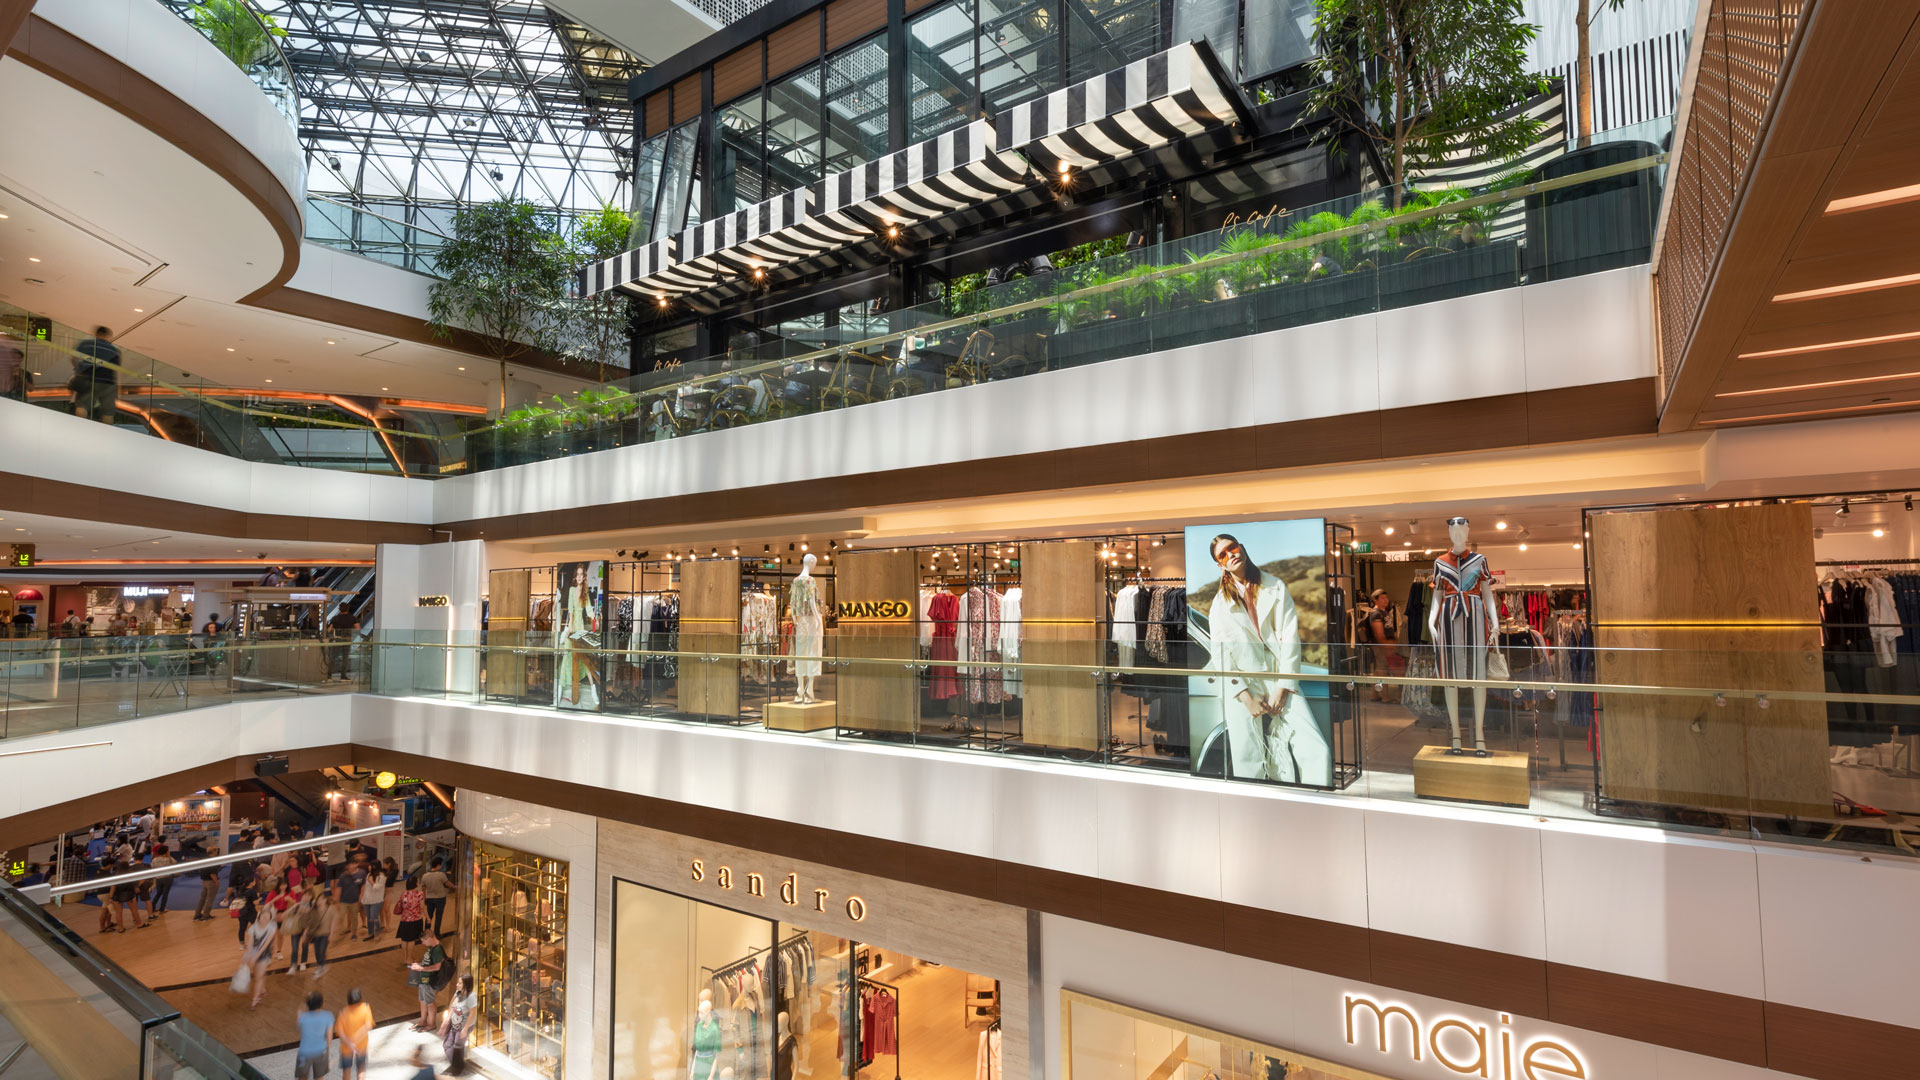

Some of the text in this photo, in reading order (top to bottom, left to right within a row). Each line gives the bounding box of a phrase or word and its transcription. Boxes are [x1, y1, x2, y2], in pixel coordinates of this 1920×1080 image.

[123, 586, 148, 597] MUJI
[838, 601, 909, 618] MANGO
[13, 861, 25, 870] L1
[690, 860, 866, 922] sandro
